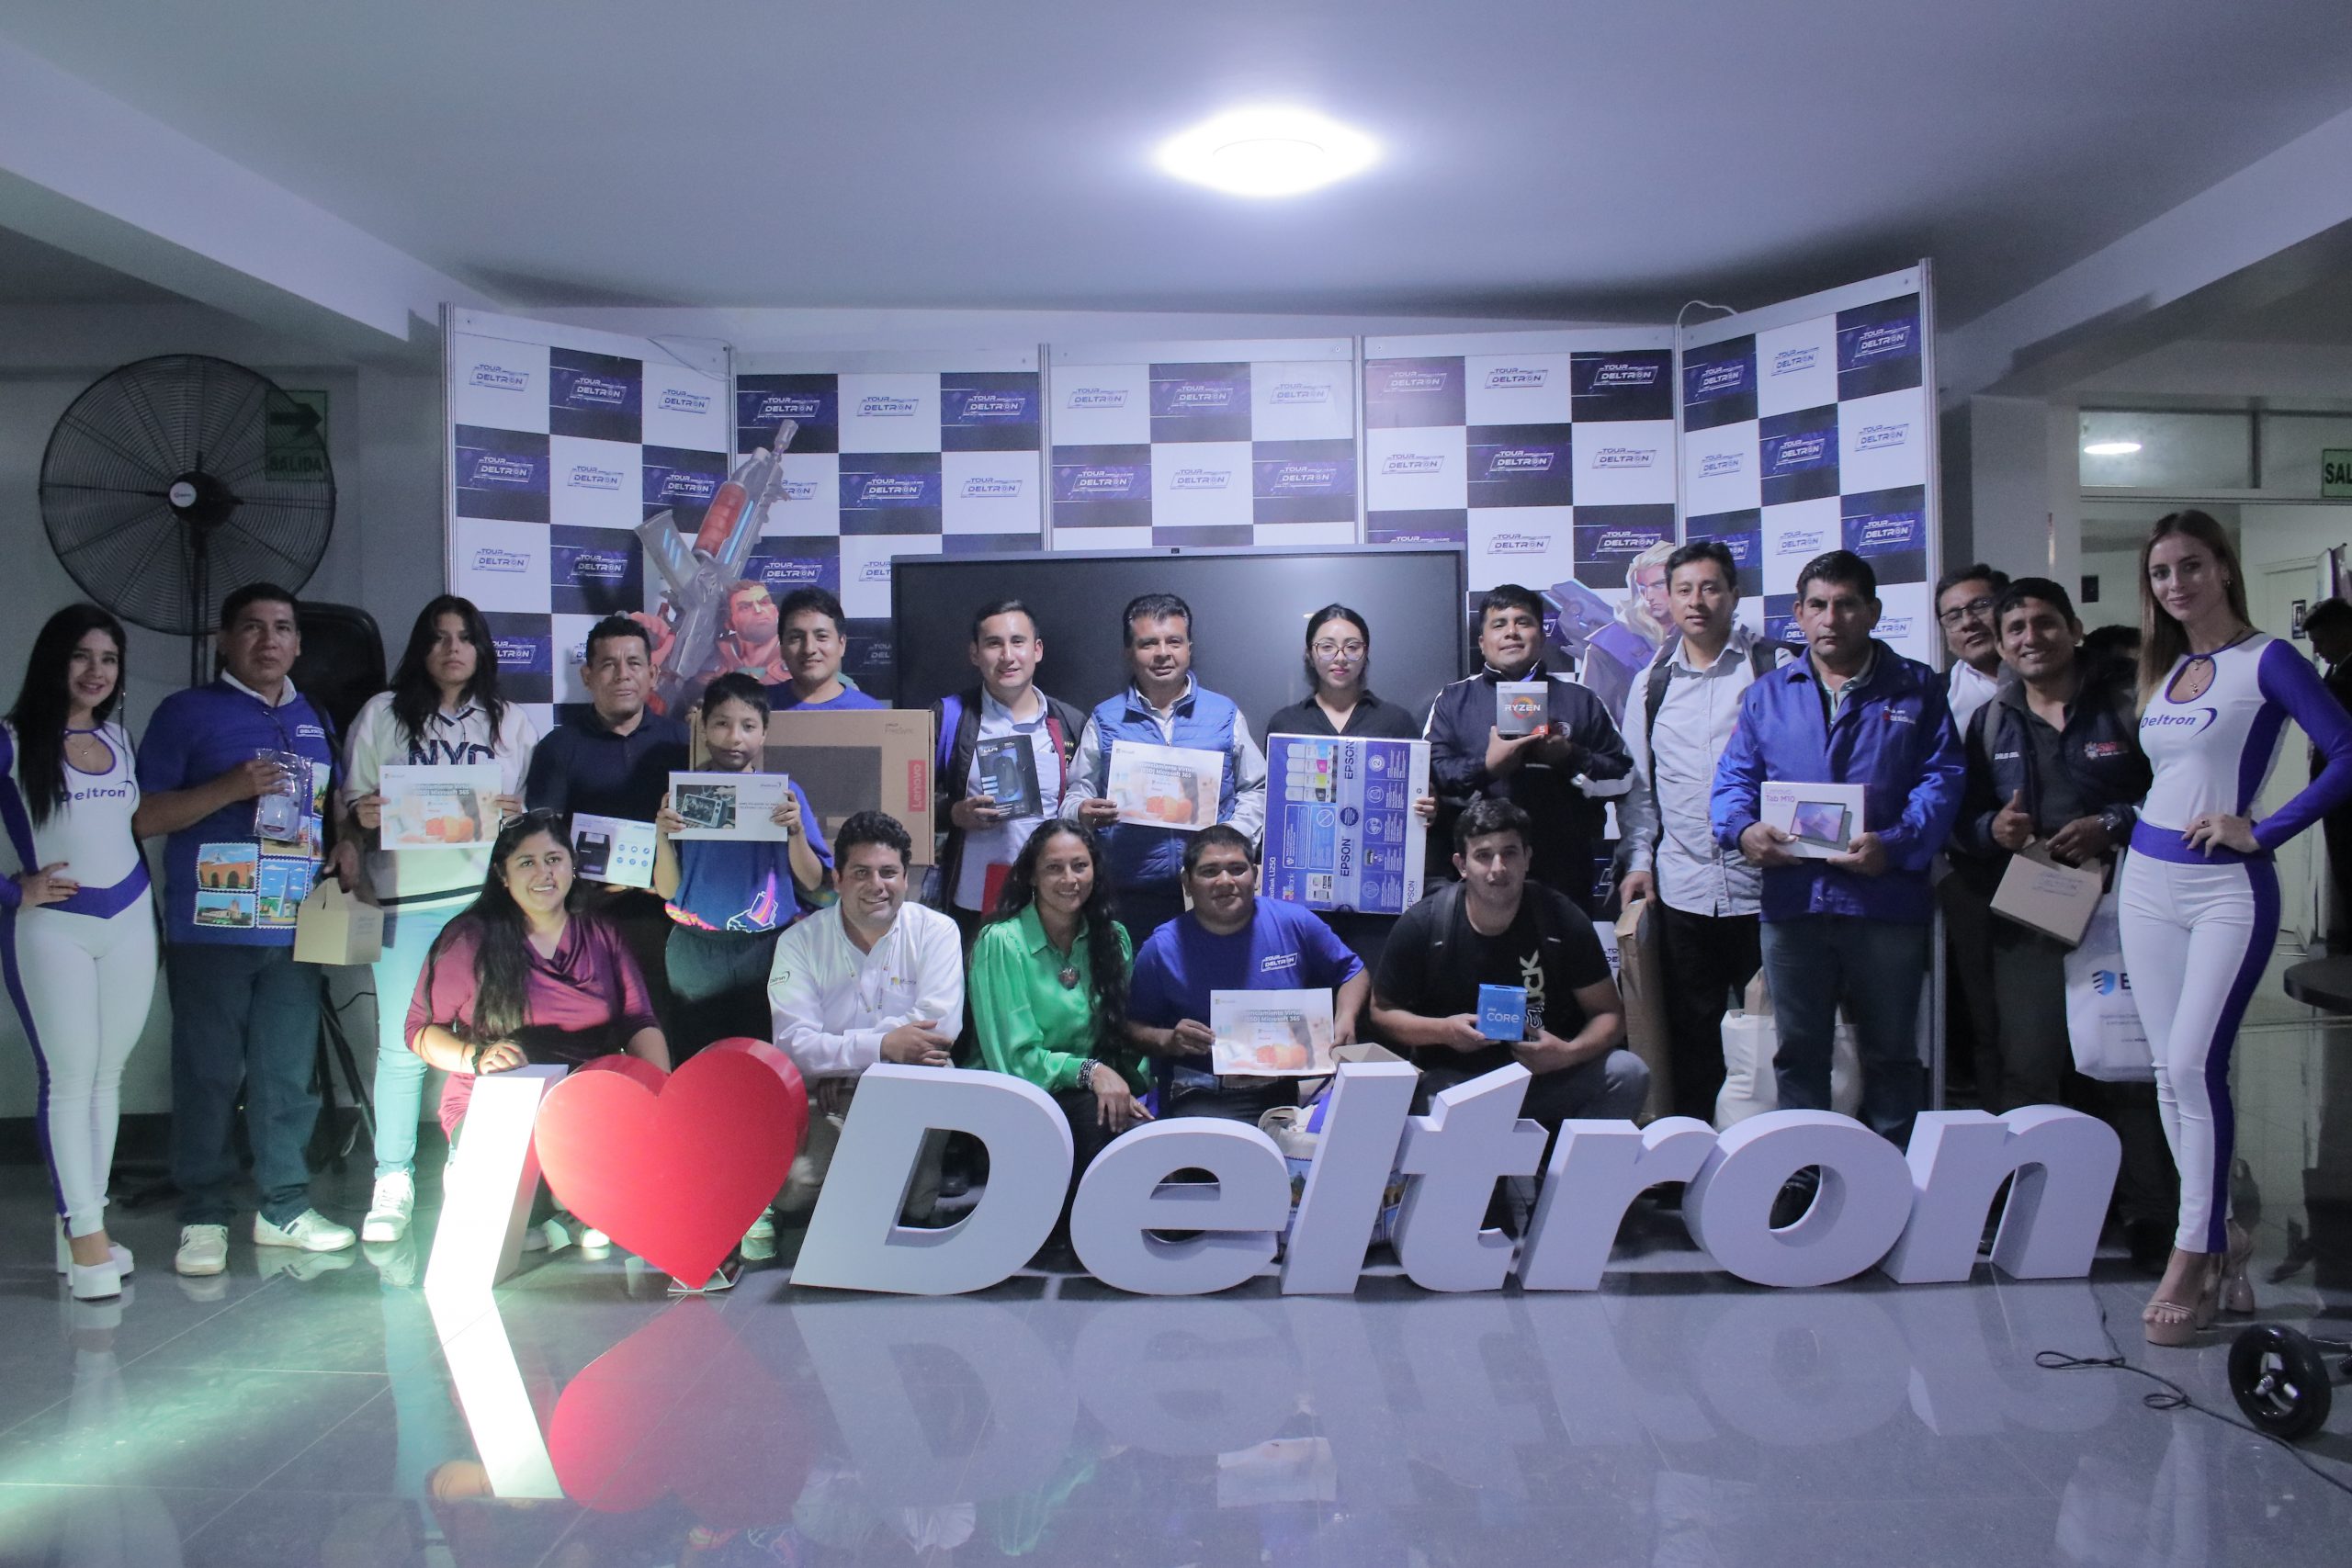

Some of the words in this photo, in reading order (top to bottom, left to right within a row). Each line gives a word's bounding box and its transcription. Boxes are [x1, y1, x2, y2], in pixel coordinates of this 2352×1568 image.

[1863, 329, 1883, 339] TOUR
[1861, 334, 1904, 349] DELTRON
[1778, 350, 1796, 358] TOUR
[1776, 355, 1814, 368] DELTRON
[480, 364, 502, 372] TOUR
[1705, 367, 1723, 376] TOUR
[476, 373, 523, 385] DELTRON
[1492, 375, 1541, 383] DELTRON
[1601, 371, 1651, 379] DELTRON
[1703, 372, 1738, 385] DELTRON
[580, 378, 601, 386] TOUR
[1391, 378, 1440, 387] DELTRON
[577, 386, 620, 398] DELTRON
[667, 389, 686, 397] TOUR
[1179, 393, 1227, 401] DELTRON
[1276, 390, 1324, 399] DELTRON
[664, 397, 705, 408] DELTRON
[865, 403, 912, 412] DELTRON
[970, 402, 1018, 412] DELTRON
[765, 404, 813, 413] DELTRON
[1862, 424, 1883, 433] TOUR
[1860, 431, 1903, 445] DELTRON
[1783, 439, 1803, 448] TOUR
[1781, 446, 1819, 459] DELTRON
[483, 457, 505, 465] TOUR
[1498, 457, 1547, 466] DELTRON
[1599, 455, 1649, 463] DELTRON
[1702, 459, 1738, 471] DELTRON
[481, 465, 527, 477] DELTRON
[2324, 462, 2352, 484] SAL
[574, 473, 617, 485] DELTRON
[1080, 478, 1127, 486] DELTRON
[1177, 476, 1225, 484] DELTRON
[667, 482, 709, 492] DELTRON
[869, 486, 917, 494] DELTRON
[967, 485, 1015, 493] DELTRON
[1865, 527, 1908, 539] DELTRON
[1781, 538, 1818, 548] DELTRON
[479, 557, 525, 568] DELTRON
[578, 562, 622, 572] DELTRON
[1504, 704, 1541, 712] RYZEN
[2141, 715, 2197, 728] Deltron
[1344, 741, 1354, 779] EPSON
[912, 764, 922, 808] Lenovo
[1340, 838, 1351, 876] EPSON
[425, 1064, 566, 1297] I
[789, 1060, 2121, 1297] Deltron
